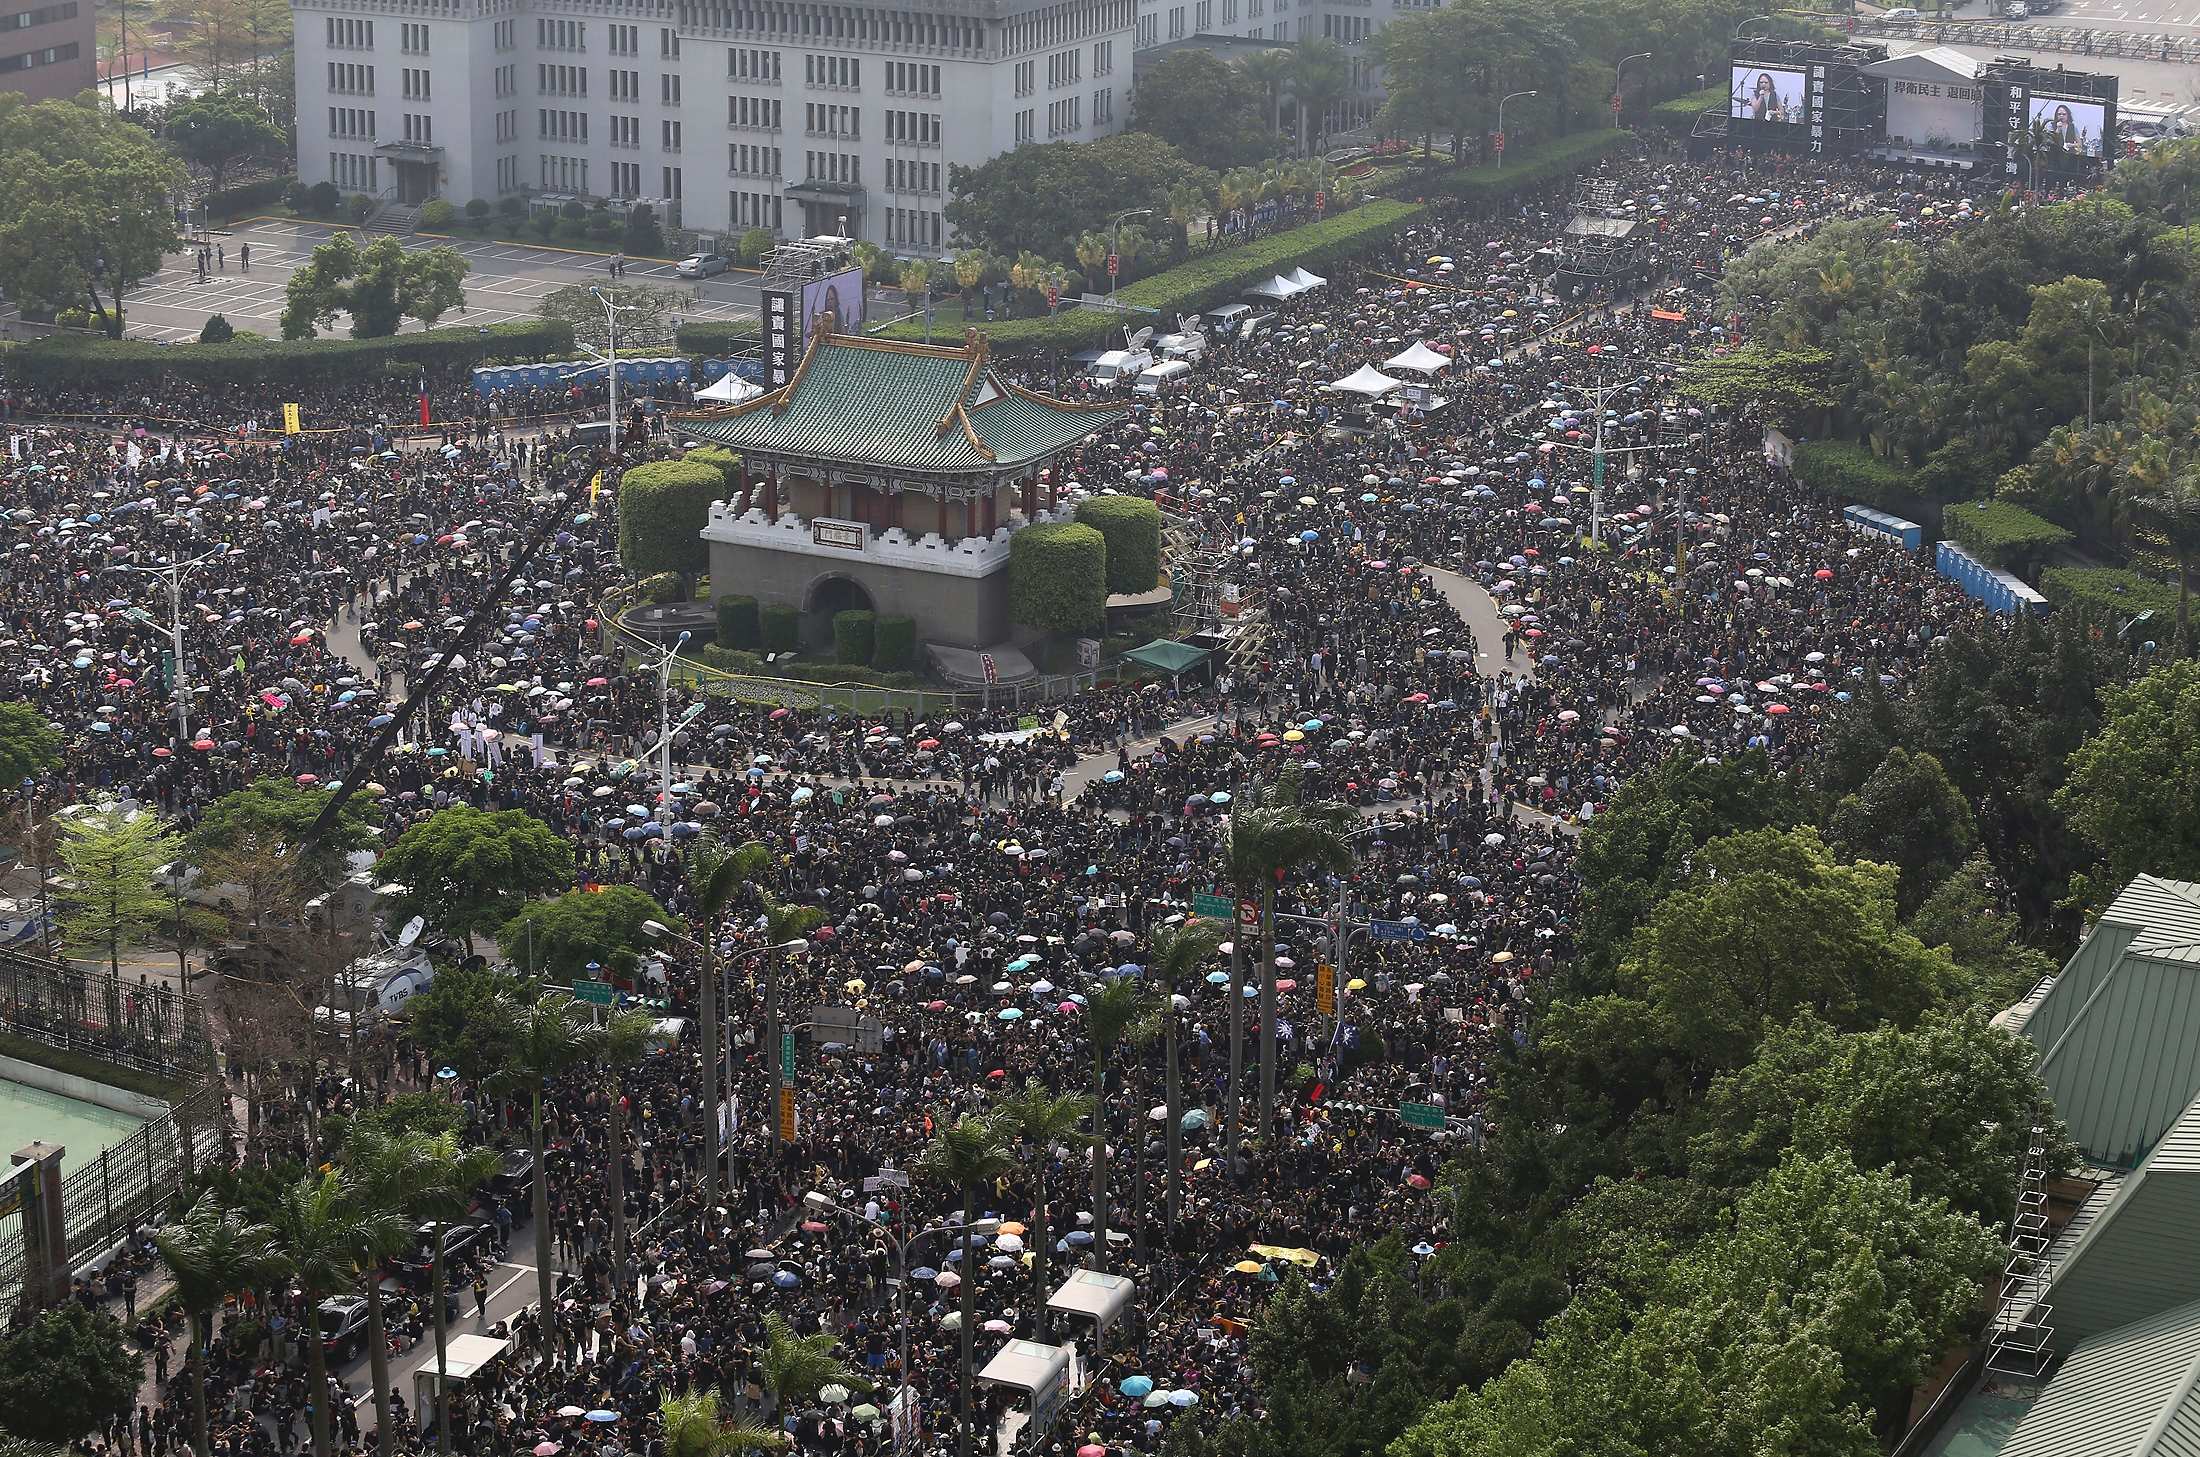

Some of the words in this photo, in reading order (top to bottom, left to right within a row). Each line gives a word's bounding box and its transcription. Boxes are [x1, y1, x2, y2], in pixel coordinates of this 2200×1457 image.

[1895, 80, 1941, 97] 捍衛民主
[2005, 86, 2022, 174] 和平守灣
[771, 296, 785, 389] 譴責國家暴
[389, 987, 409, 1002] TVBS
